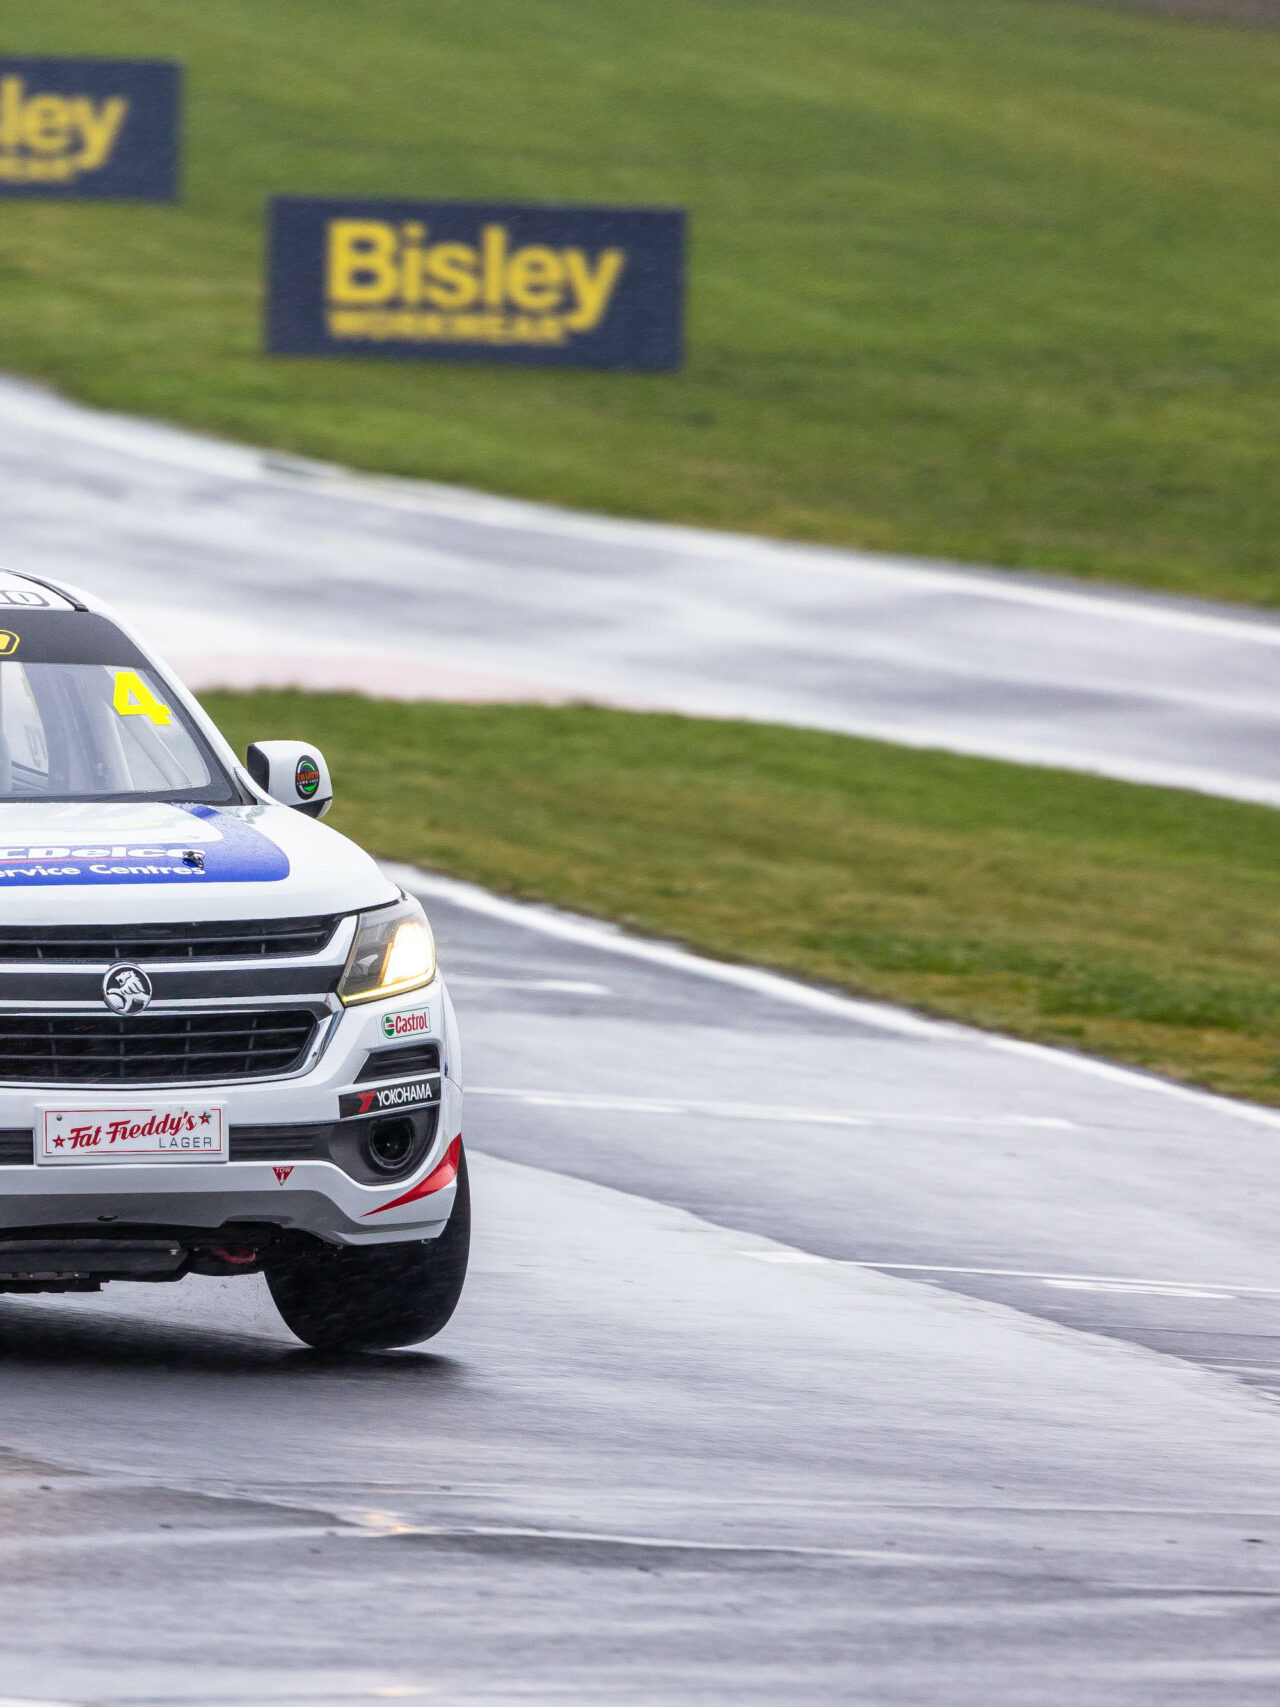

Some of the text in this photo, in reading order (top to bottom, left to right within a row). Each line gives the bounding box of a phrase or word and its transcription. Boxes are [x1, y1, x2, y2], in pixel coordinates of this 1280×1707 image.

[328, 217, 625, 332] Bisley
[113, 672, 172, 725] 4
[89, 863, 206, 876] Centres
[395, 1011, 428, 1034] Castrol
[376, 1083, 433, 1106] YOKOHAMA
[67, 1110, 198, 1150] Fat Freddy's
[158, 1136, 213, 1149] LAGER
[275, 1166, 292, 1174] TOW
